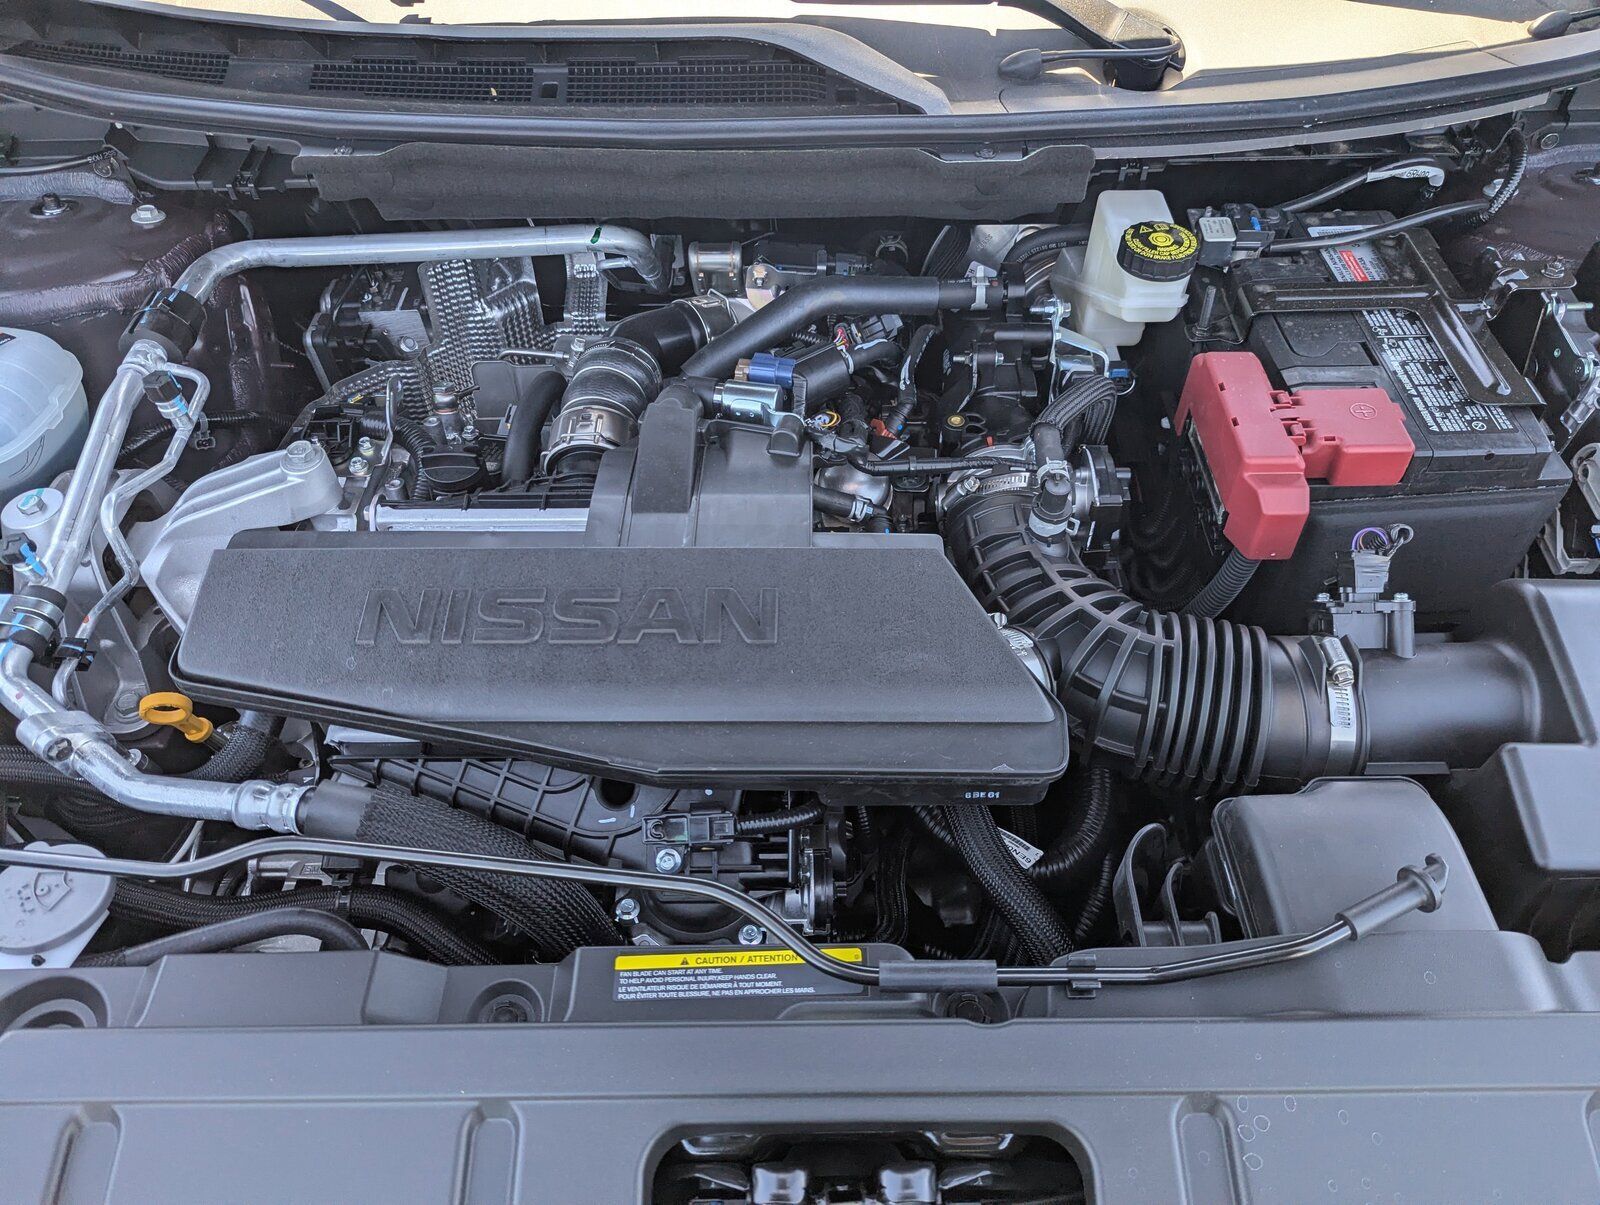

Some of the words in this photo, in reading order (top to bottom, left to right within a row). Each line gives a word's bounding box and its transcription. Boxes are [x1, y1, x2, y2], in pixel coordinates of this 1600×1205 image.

[354, 586, 780, 646] NISSAN
[695, 957, 737, 965] CAUTION
[747, 954, 799, 963] ATTENTION
